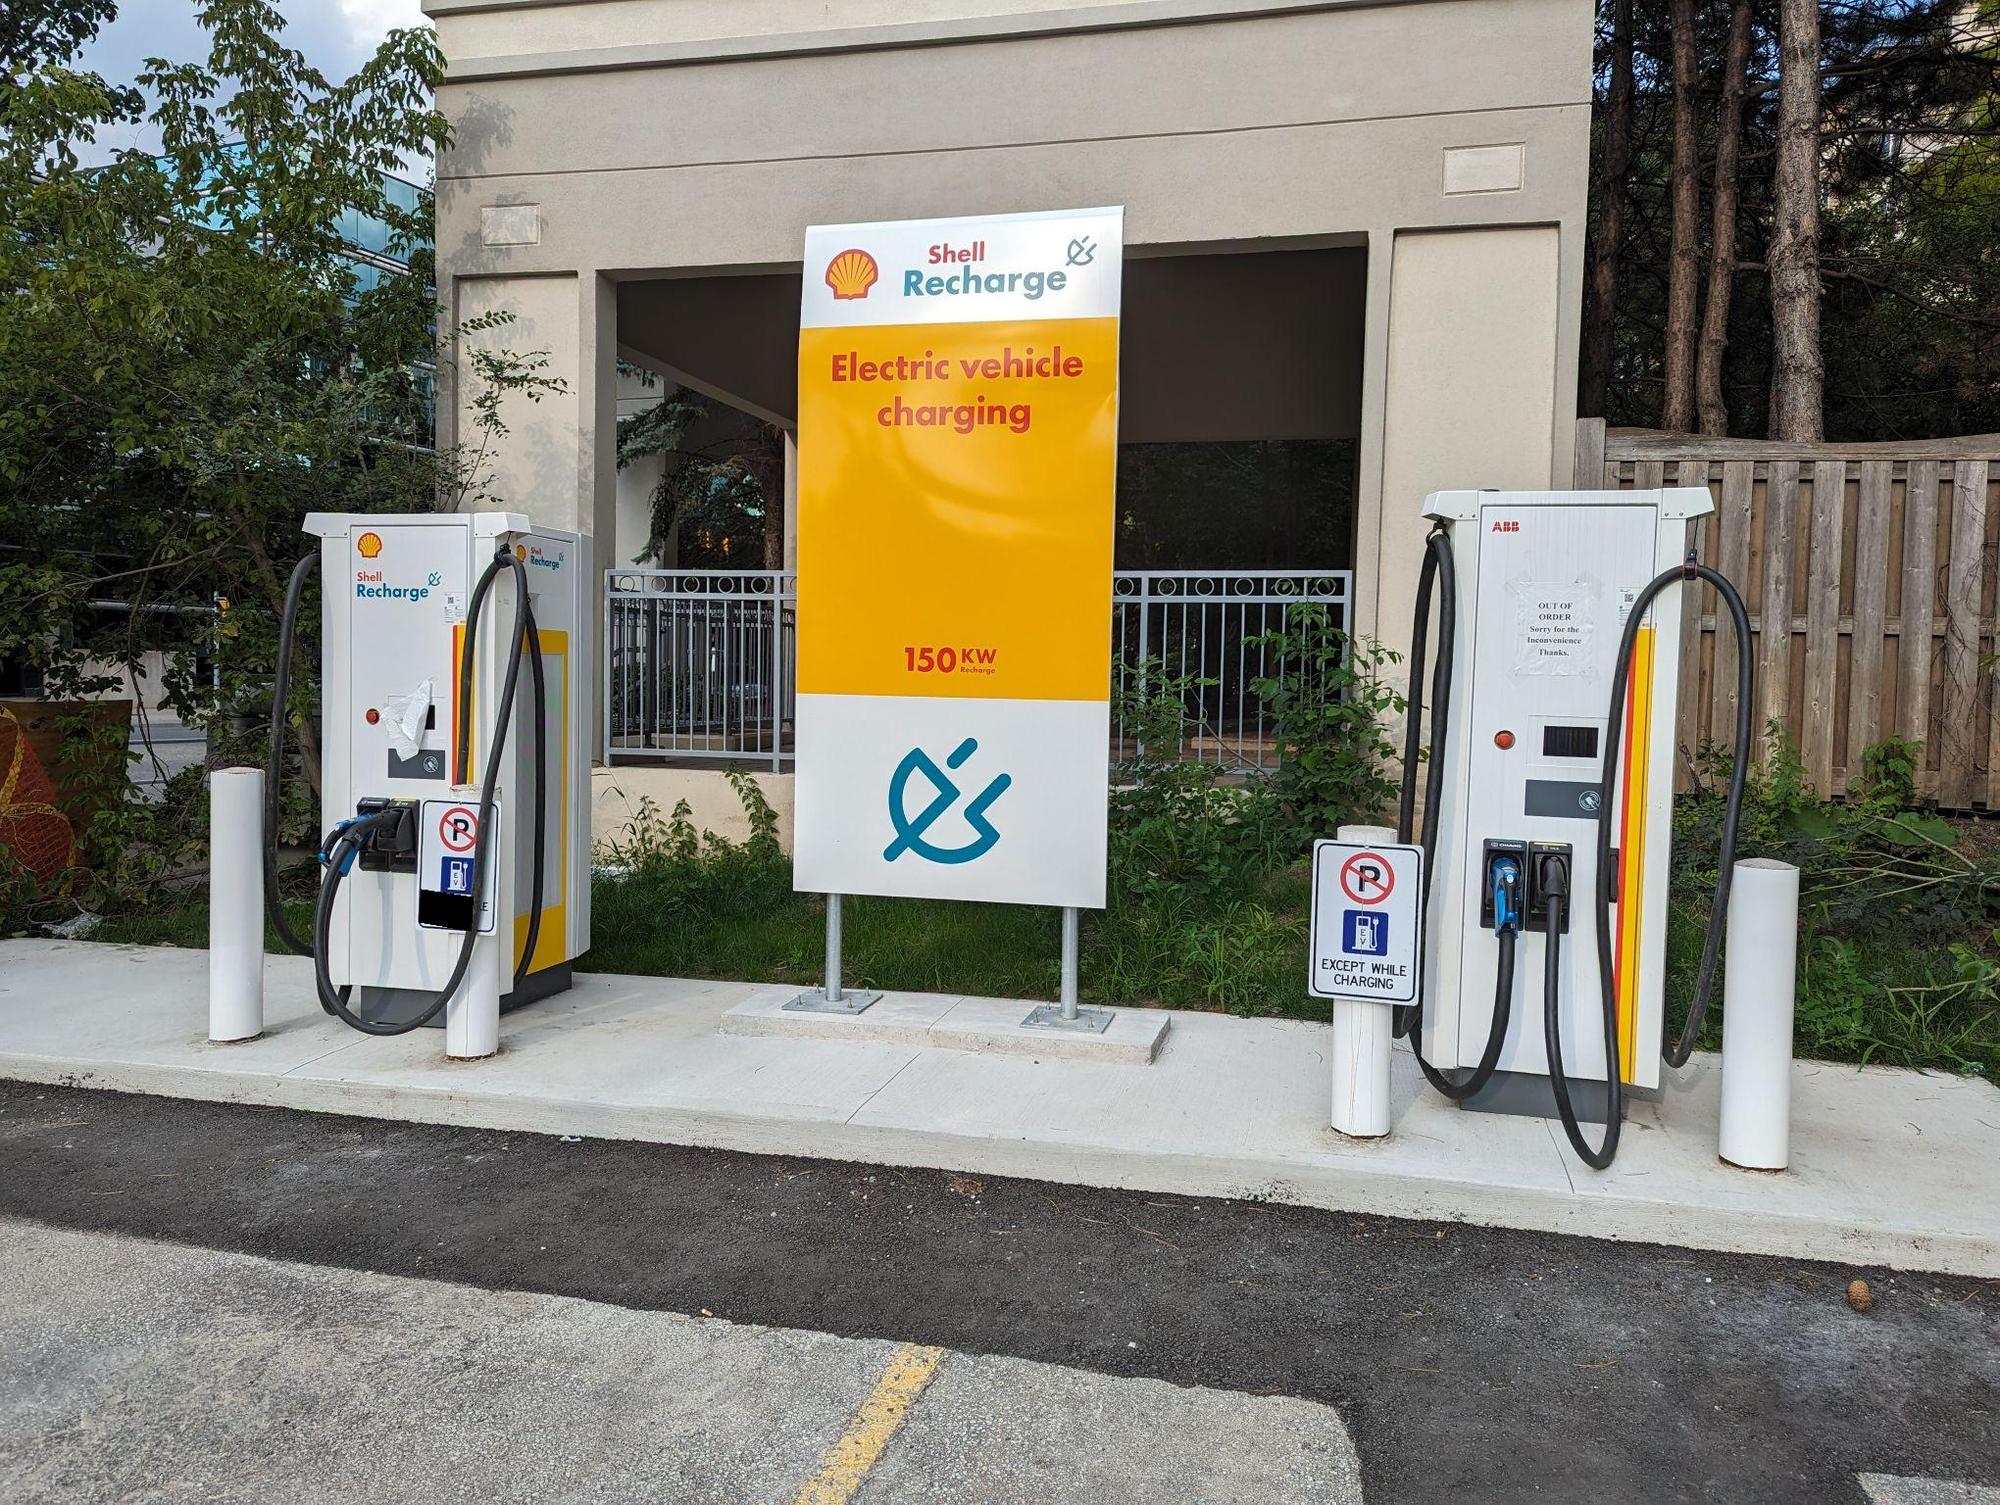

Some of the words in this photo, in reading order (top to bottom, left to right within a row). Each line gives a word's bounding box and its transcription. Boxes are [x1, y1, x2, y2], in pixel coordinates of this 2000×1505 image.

[928, 241, 985, 264] Shell
[903, 265, 1067, 300] Recharge
[832, 350, 949, 382] Electric
[960, 346, 1083, 379] vehicle
[877, 395, 1031, 434] charging
[1492, 521, 1520, 532] ABB
[530, 555, 560, 571] Recharge
[357, 571, 382, 582] Shell
[357, 583, 429, 602] Recharge
[1538, 602, 1557, 610] OUT
[1559, 602, 1574, 610] OF
[1538, 613, 1571, 621] ORDER
[1529, 625, 1551, 635] Sorry
[1553, 625, 1565, 634] for
[1567, 625, 1580, 633] the
[1527, 636, 1582, 645] Inconvenience
[905, 647, 957, 673] 150
[961, 648, 997, 664] KW
[1538, 649, 1570, 657] Thanks.
[960, 666, 996, 675] Recharge
[452, 818, 469, 842] P
[1358, 865, 1381, 892] P
[1322, 958, 1365, 973] EXCEPT
[1372, 963, 1407, 977] WHILE
[1334, 973, 1394, 990] CHARGING
